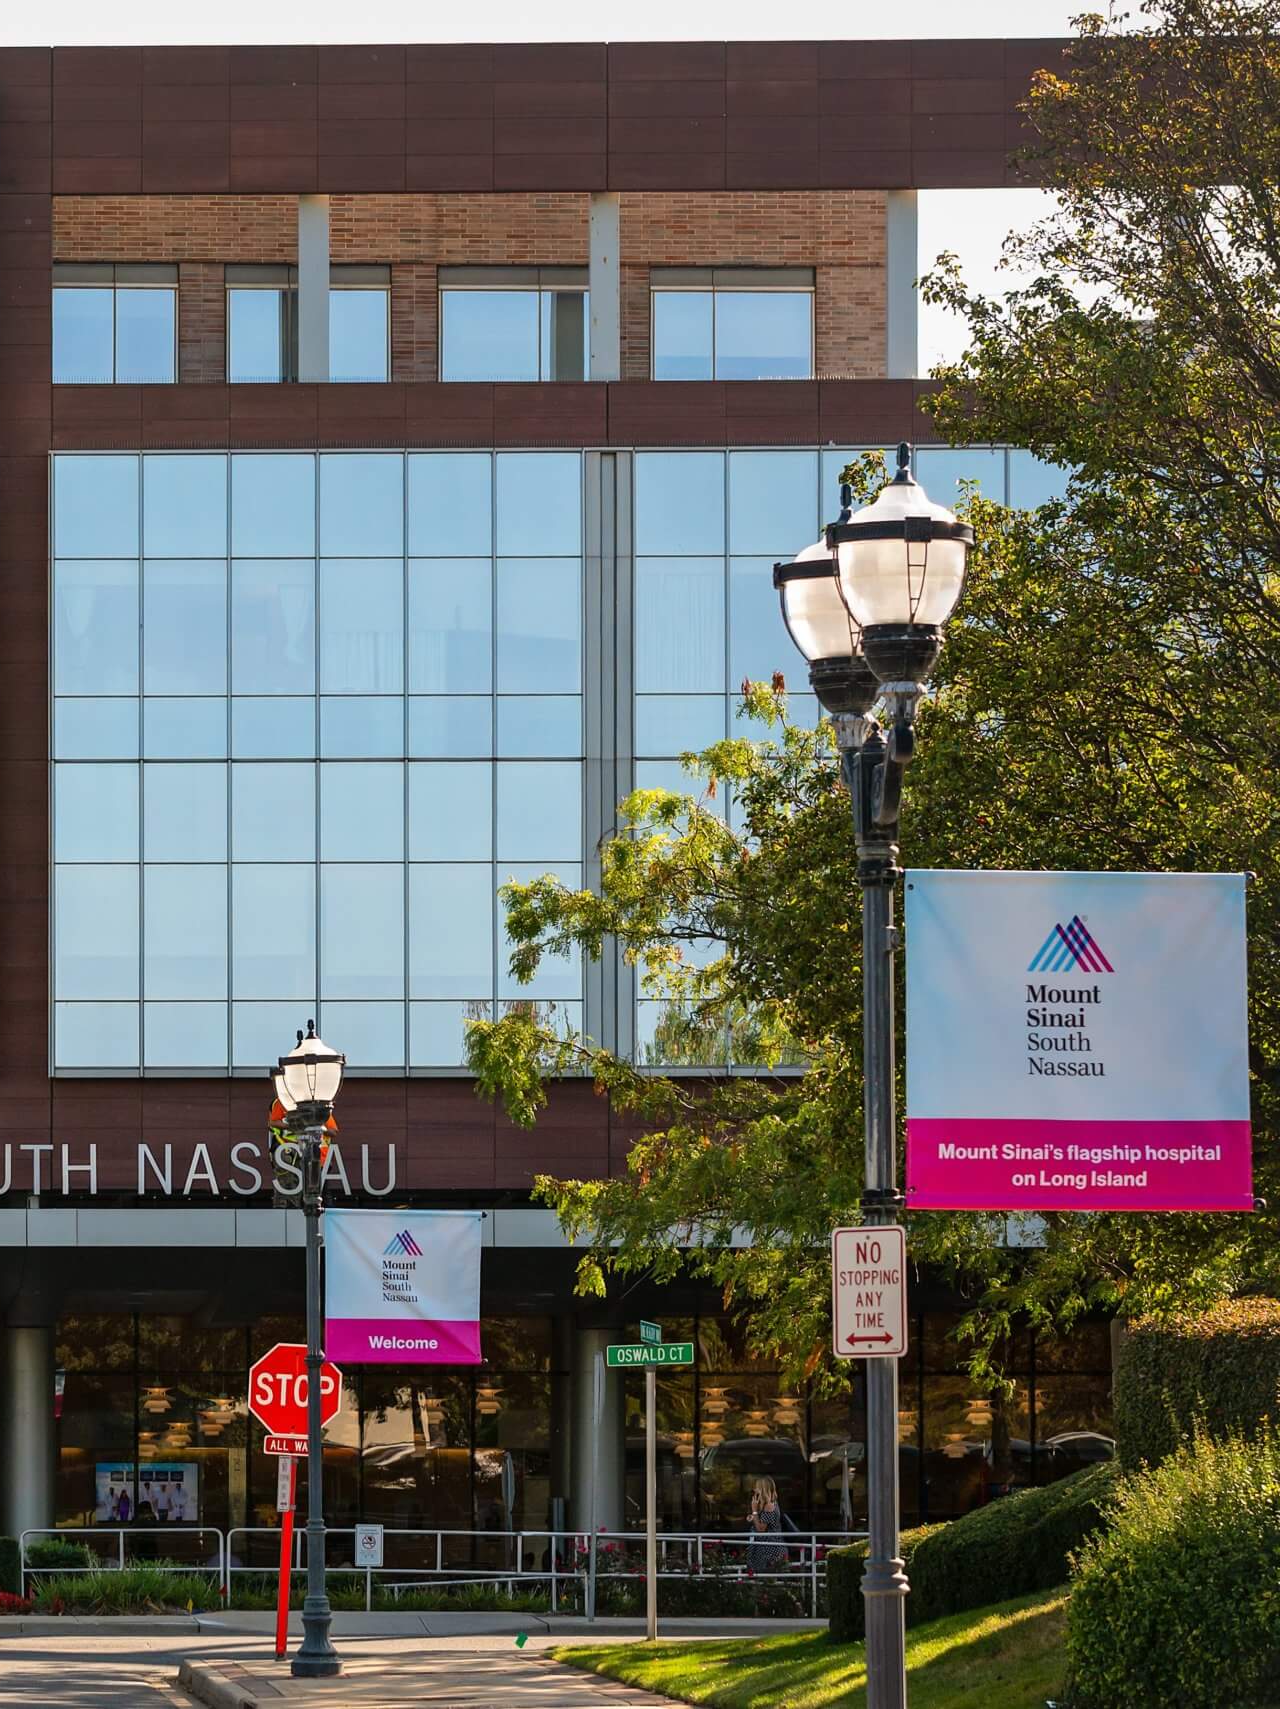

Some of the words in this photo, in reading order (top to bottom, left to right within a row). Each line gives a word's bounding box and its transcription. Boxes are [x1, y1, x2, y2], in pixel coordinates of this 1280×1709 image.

[1025, 984, 1101, 1004] Mount
[1026, 1007, 1086, 1028] Sinai
[1027, 1031, 1092, 1052] South
[1027, 1056, 1106, 1077] Nassau
[938, 1143, 998, 1160] Mount
[1066, 1144, 1142, 1164] flagship
[1145, 1145, 1221, 1164] hospital
[138, 1141, 396, 1196] NASSAU
[1011, 1173, 1036, 1187] on
[1039, 1170, 1087, 1190] Long
[1091, 1170, 1148, 1187] Island
[856, 1241, 882, 1265] NO
[382, 1260, 416, 1270] Mount
[382, 1270, 409, 1281] Sinai
[839, 1269, 900, 1287] STOPPING
[382, 1281, 412, 1292] South
[382, 1292, 418, 1303] Nassau
[855, 1291, 883, 1308] ANY
[855, 1312, 885, 1329] TIME
[368, 1335, 439, 1350] Welcome
[617, 1347, 666, 1363] OSWALD
[669, 1346, 685, 1361] CT
[270, 1439, 289, 1452] ALL
[294, 1440, 309, 1453] WA
